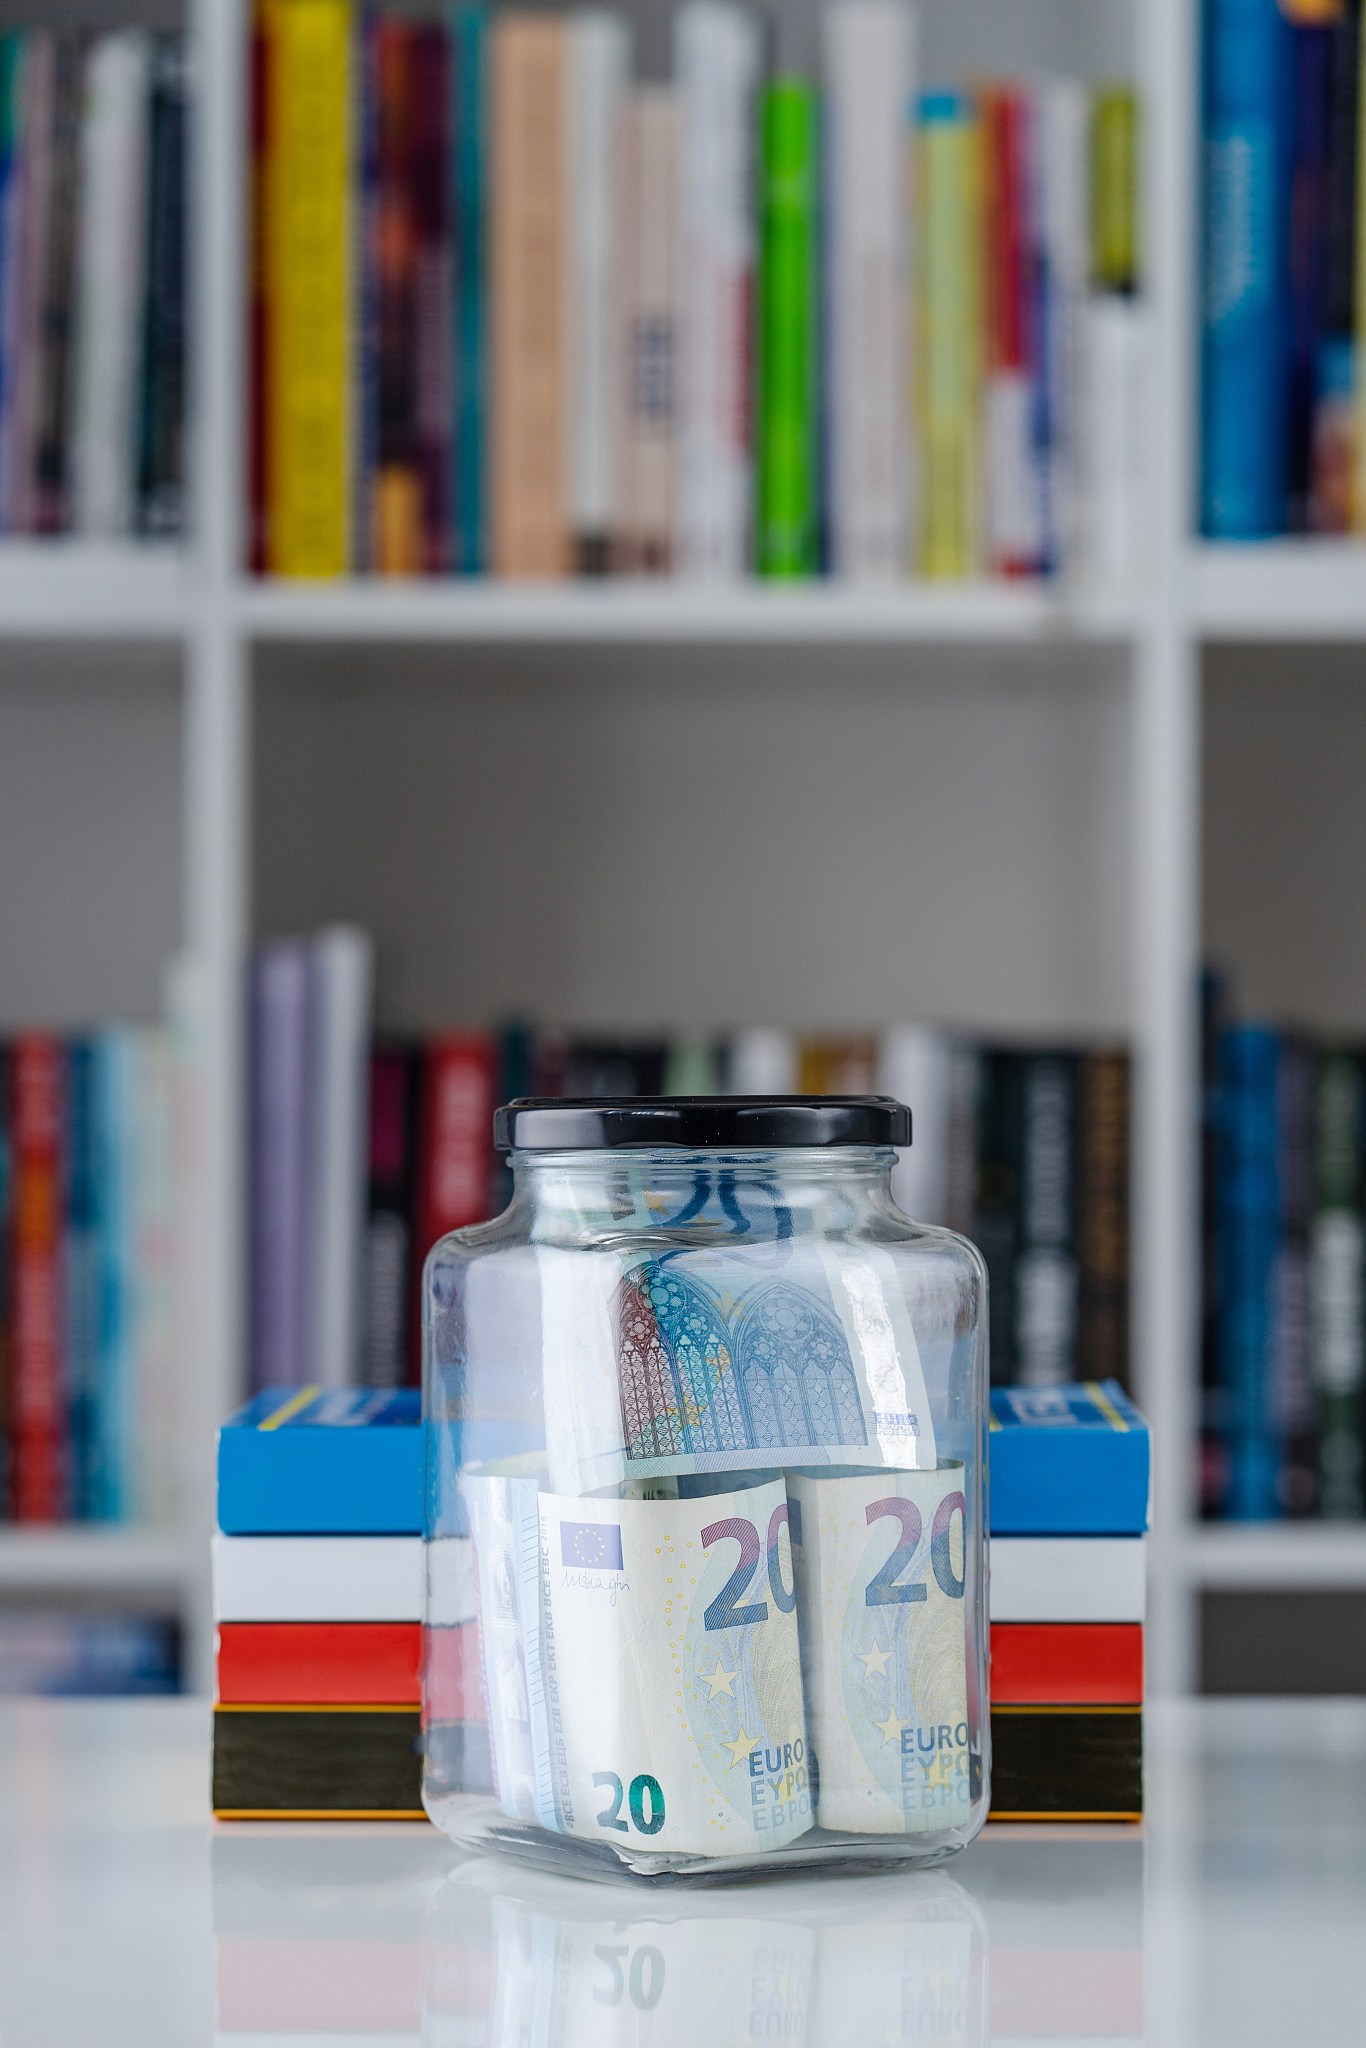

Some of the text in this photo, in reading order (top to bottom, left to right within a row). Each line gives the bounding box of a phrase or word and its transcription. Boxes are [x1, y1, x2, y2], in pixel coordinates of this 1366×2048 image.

[541, 1547, 550, 1575] EBC
[865, 1490, 966, 1607] 20
[700, 1503, 797, 1632] 20
[544, 1611, 555, 1640] EKB
[547, 1643, 557, 1671] EKT
[549, 1675, 559, 1704] EKP
[552, 1707, 563, 1734] EZB
[901, 1722, 969, 1754] EURO
[748, 1737, 804, 1777] EURO
[558, 1770, 570, 1797] ECB
[591, 1771, 666, 1835] 20
